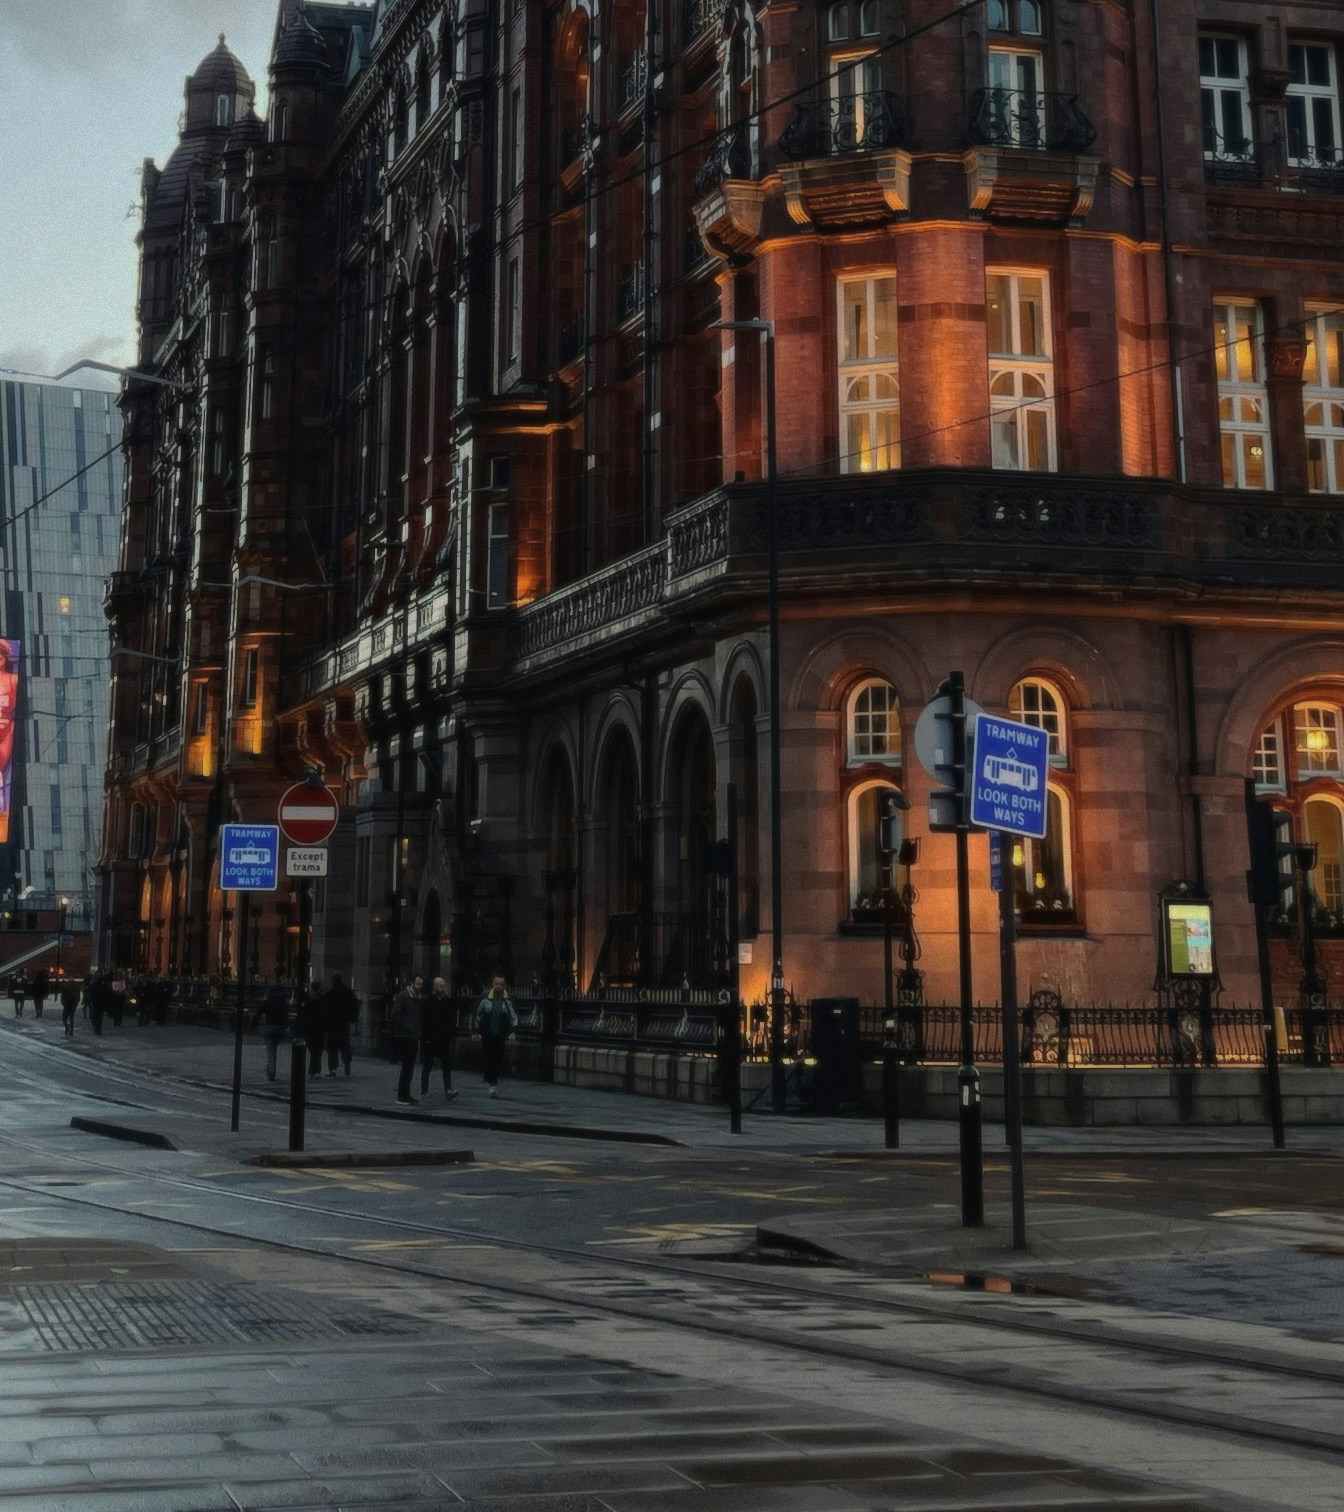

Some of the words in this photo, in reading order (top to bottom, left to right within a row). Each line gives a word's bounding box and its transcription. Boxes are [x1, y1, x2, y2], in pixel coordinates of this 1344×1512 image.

[986, 723, 1040, 748] TRAMWAY
[978, 787, 1009, 806] LOOK
[1012, 796, 1041, 814] BOTH
[993, 807, 1025, 826] WAYS
[230, 829, 272, 838] TRAMWAY
[291, 851, 324, 862] Except
[225, 867, 248, 876] LOOK
[250, 867, 273, 876] BOTH
[294, 862, 321, 871] trams
[237, 877, 261, 886] WAYS
